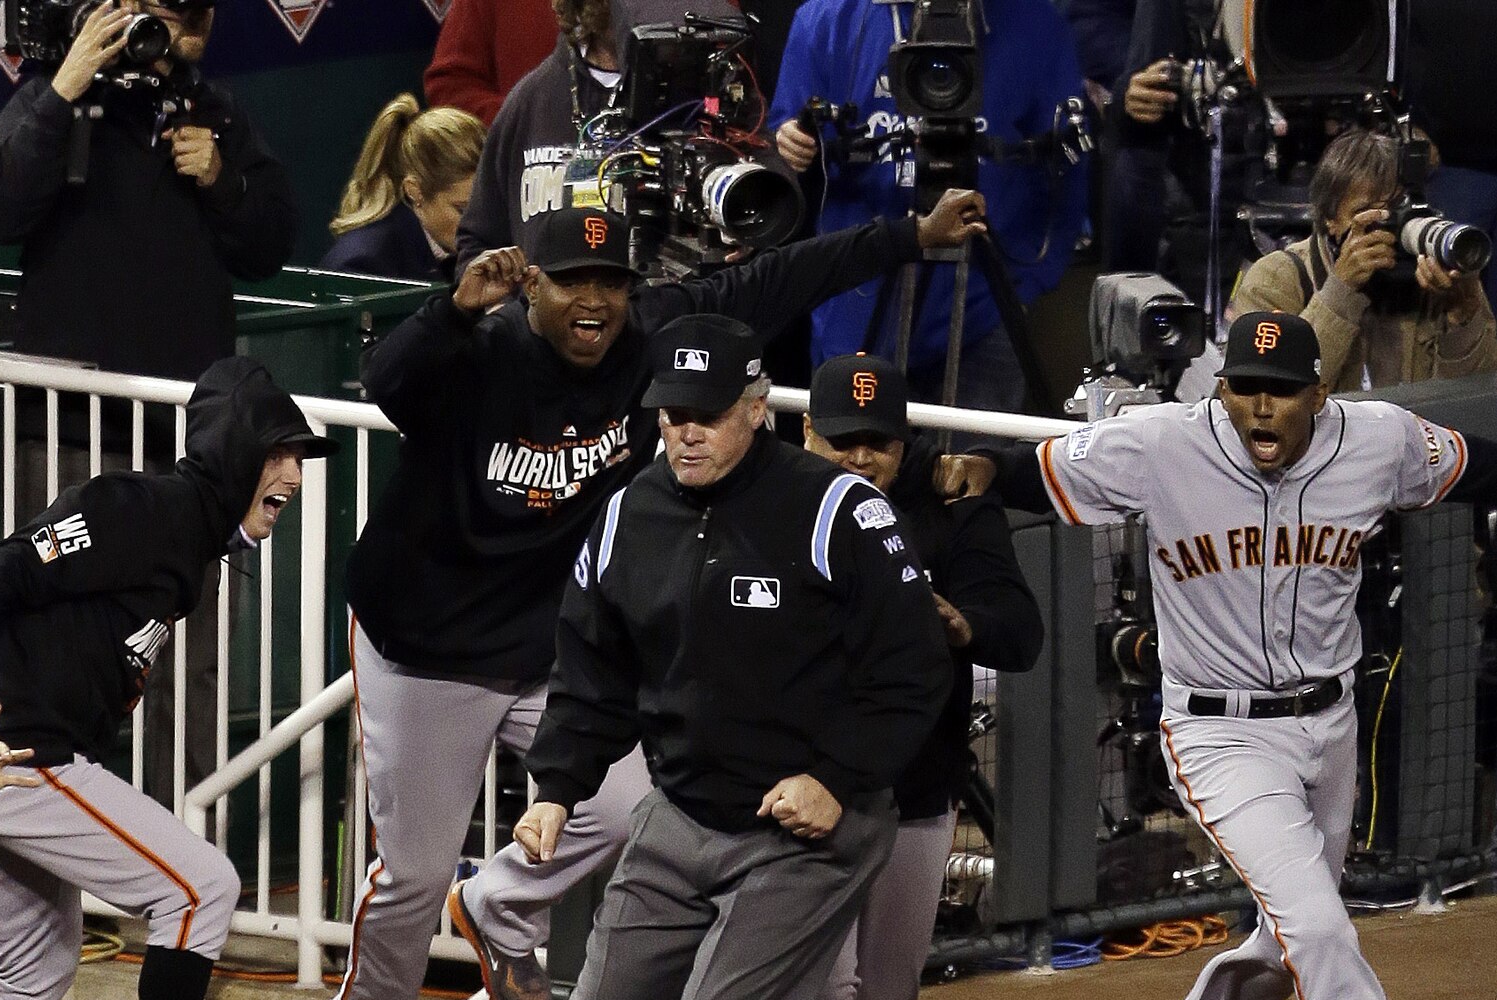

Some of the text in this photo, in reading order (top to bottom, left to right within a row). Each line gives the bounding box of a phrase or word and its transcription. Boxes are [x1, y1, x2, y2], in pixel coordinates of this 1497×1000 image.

[486, 442, 568, 490] WORLD
[53, 512, 93, 556] WS
[1156, 532, 1222, 584] SAN
